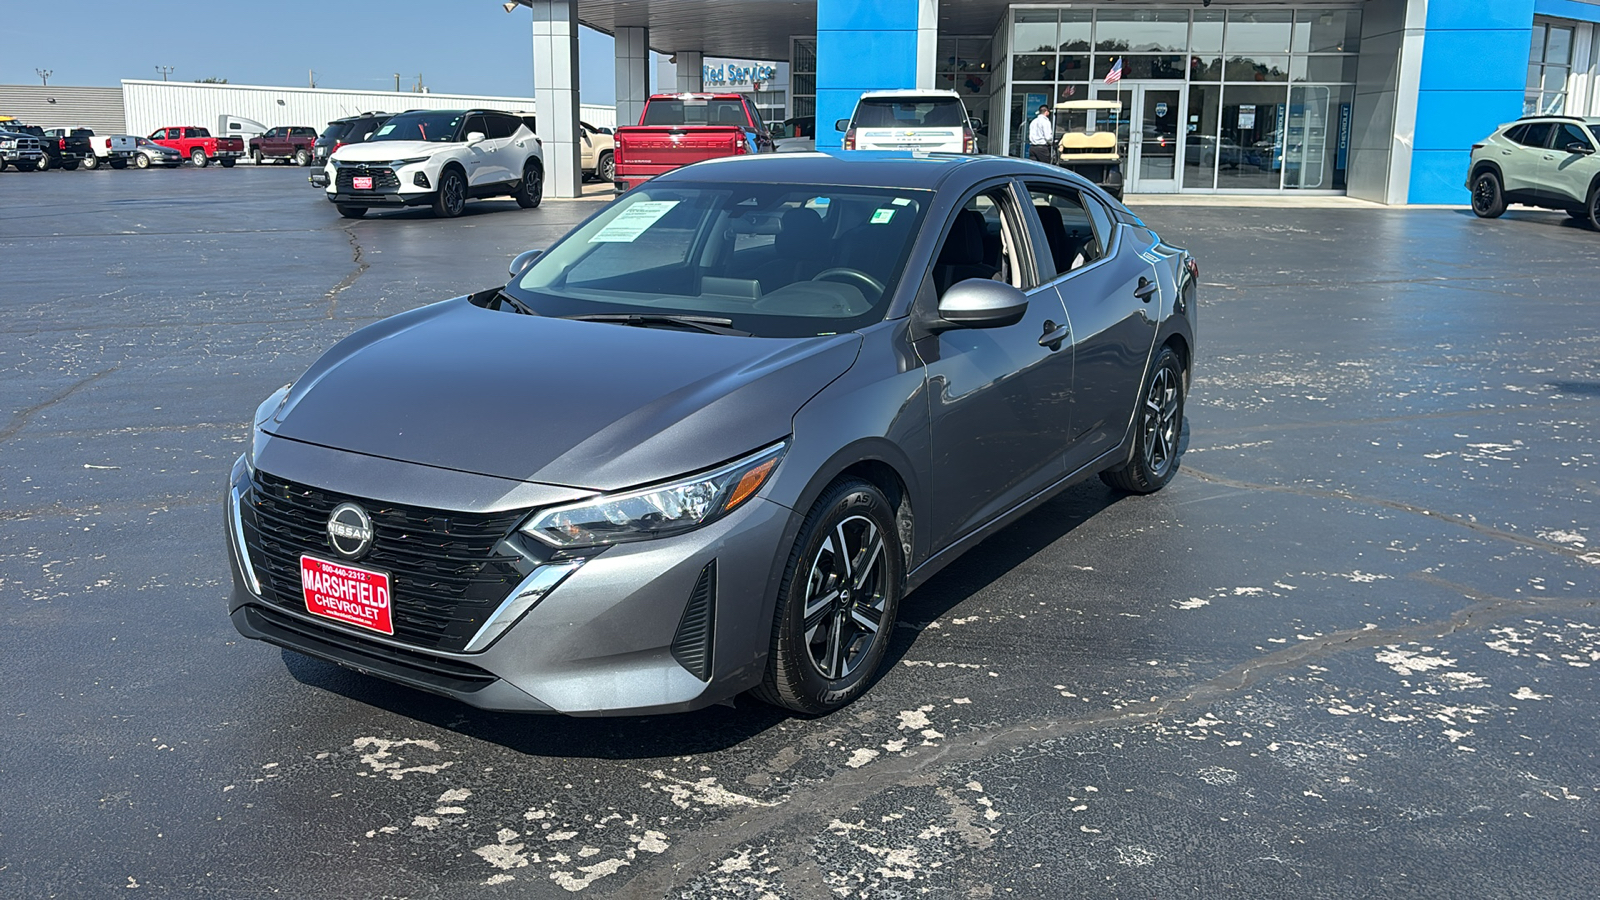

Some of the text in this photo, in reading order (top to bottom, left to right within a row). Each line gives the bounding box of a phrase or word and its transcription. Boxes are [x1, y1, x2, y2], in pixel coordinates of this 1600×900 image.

[728, 62, 772, 81] Service
[1341, 107, 1349, 149] CHEVROLET
[328, 520, 371, 540] NISSAN
[321, 563, 366, 581] 800-440-2312
[303, 568, 388, 609] MARSHFIELD
[314, 594, 379, 620] CHEVROLET
